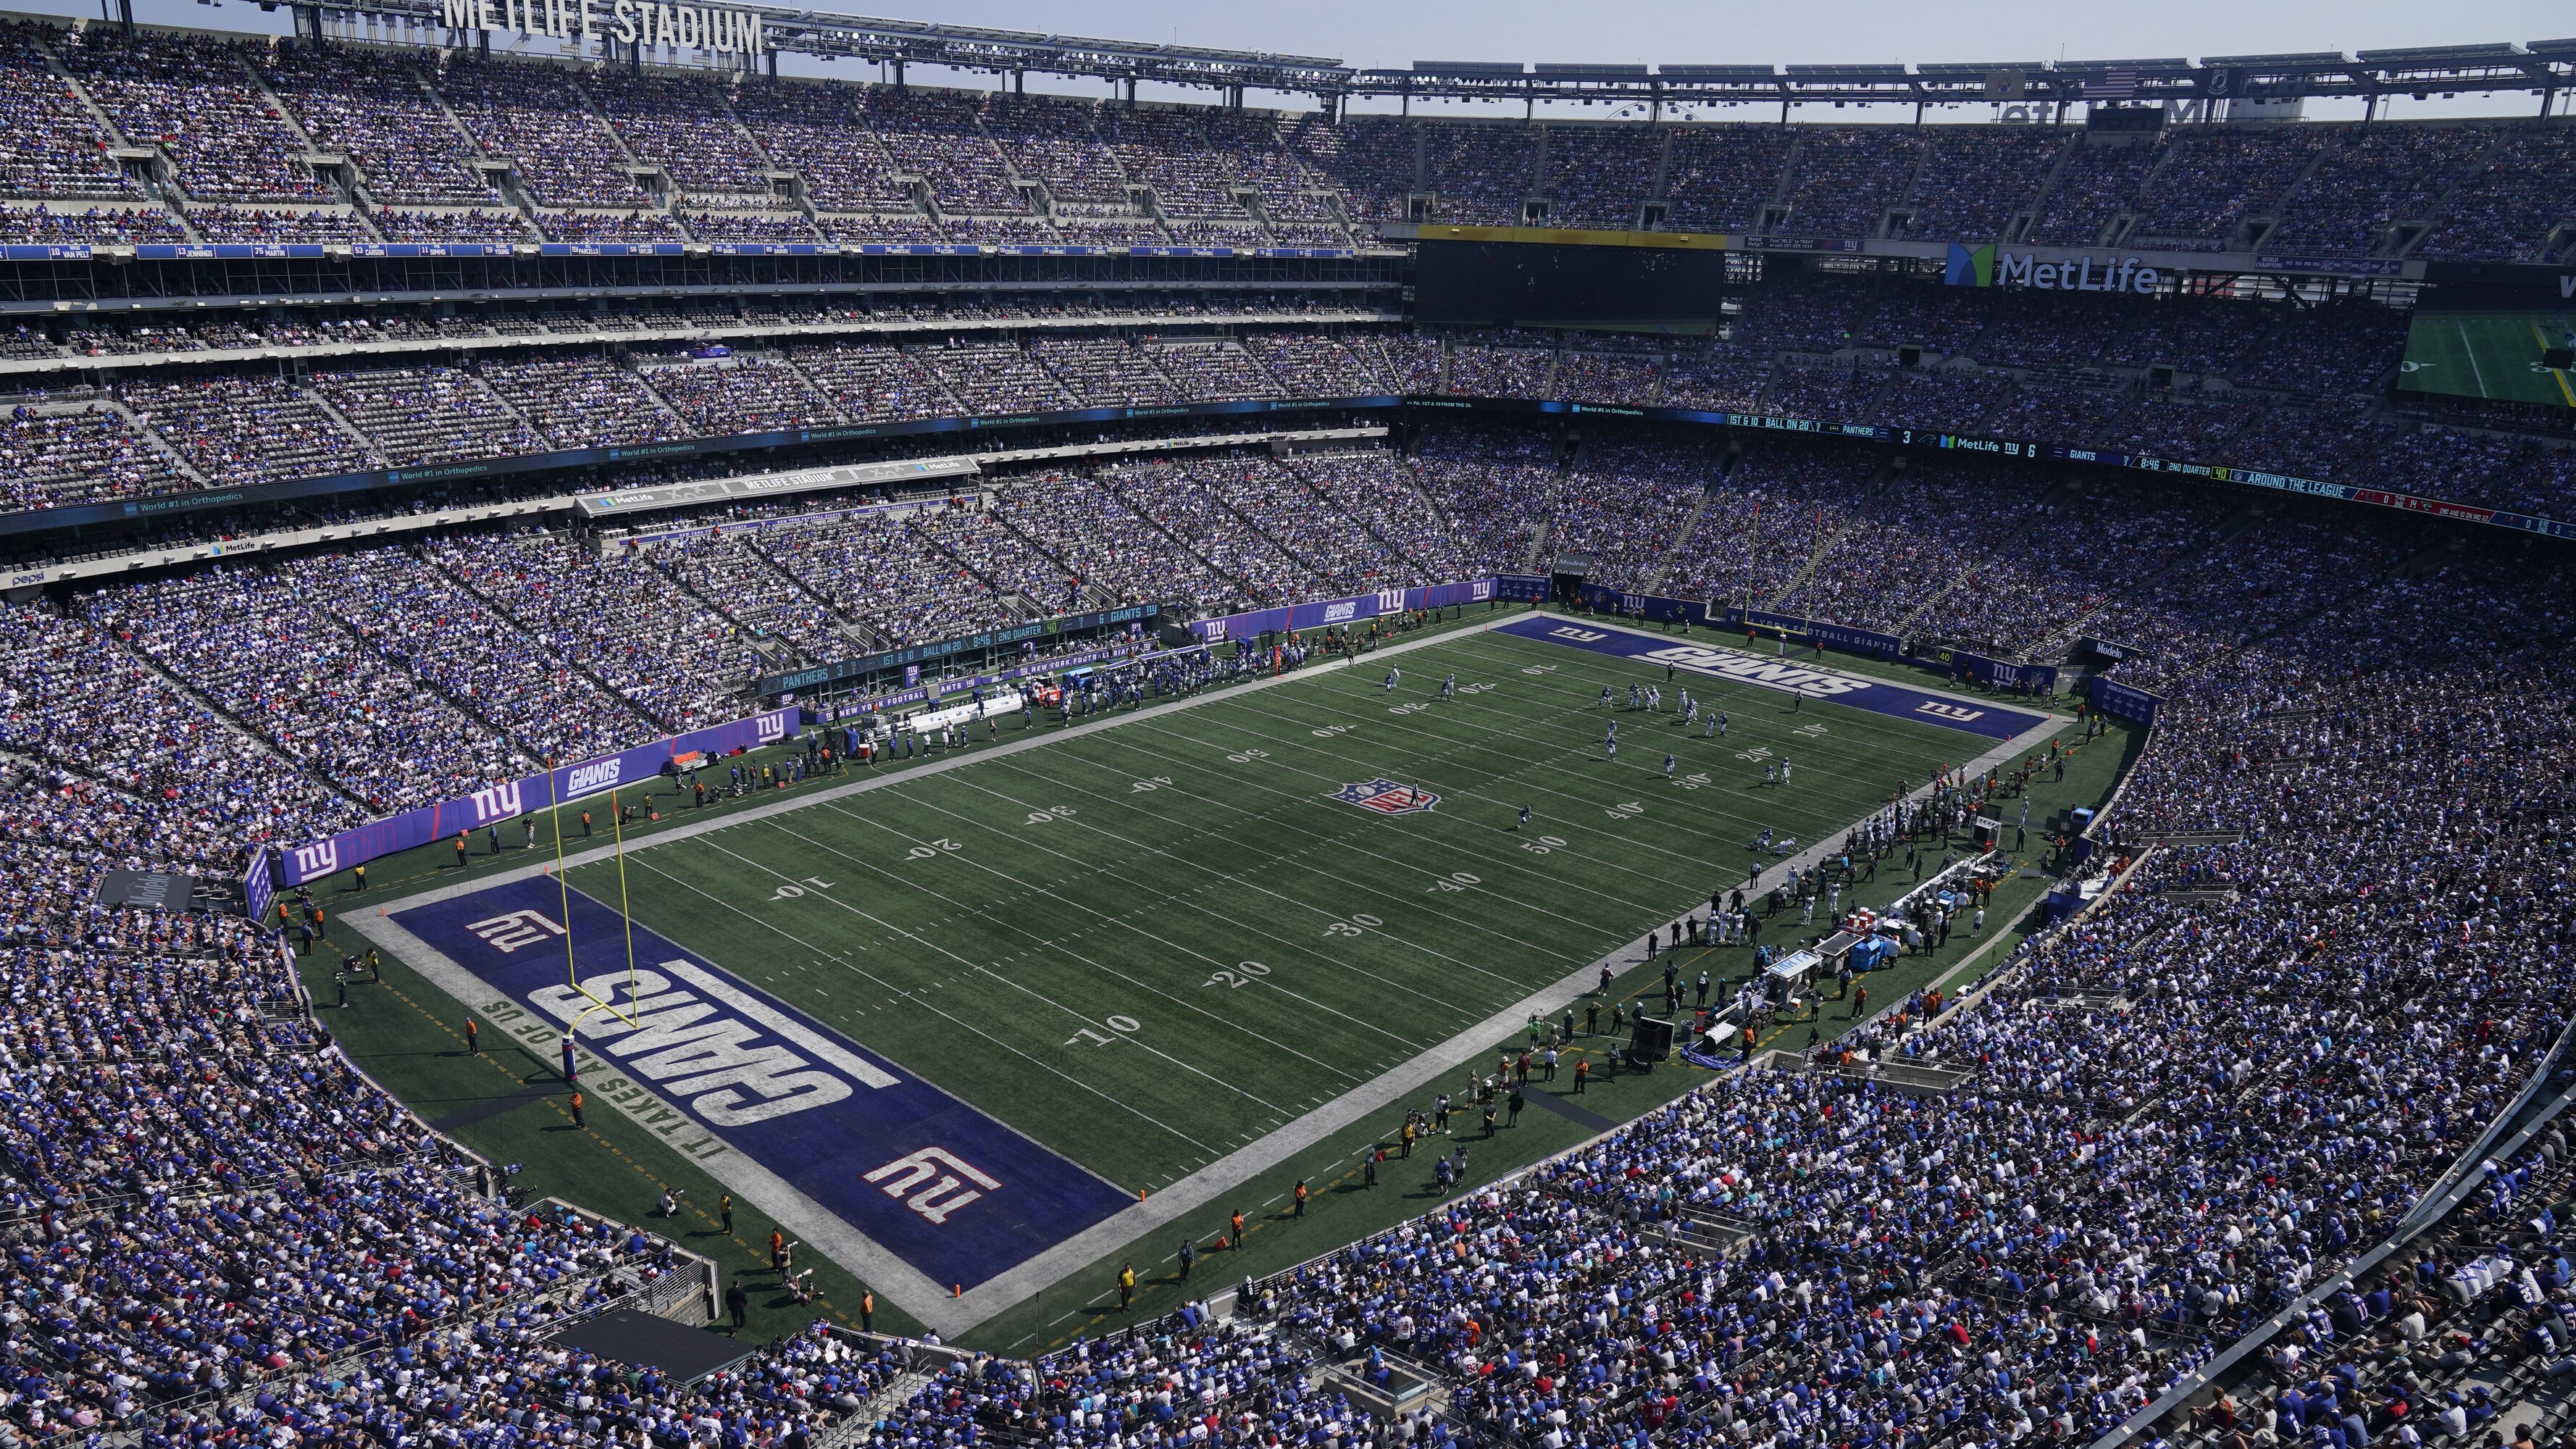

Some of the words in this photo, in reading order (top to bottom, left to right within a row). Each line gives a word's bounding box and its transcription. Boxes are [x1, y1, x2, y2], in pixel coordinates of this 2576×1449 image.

[443, 0, 602, 41] METLIFE
[614, 1, 761, 54] STADIUM
[1998, 253, 2158, 294] MetLife
[1730, 416, 1740, 425] 1ST
[1752, 417, 1758, 426] 10
[1765, 418, 1783, 428] BALL
[1786, 420, 1797, 429] ON
[1843, 425, 1873, 436] PANTHERS
[1903, 430, 1911, 444] 3
[1957, 438, 1999, 452] MetLife
[2004, 442, 2019, 455] ny
[2028, 444, 2036, 458] 6
[2070, 449, 2096, 462] GIANTS
[401, 471, 422, 480] World
[444, 465, 488, 475] Orthopedics
[928, 461, 961, 472] MetLife
[2141, 459, 2159, 469] 8:46
[2169, 462, 2181, 472] 2ND
[2183, 464, 2210, 476] QUARTER
[745, 477, 790, 491] METLIFE
[793, 472, 836, 486] STADIUM
[2216, 469, 2226, 479] 40
[2248, 472, 2285, 489] AROUND
[2288, 479, 2306, 492] THE
[2308, 483, 2345, 498] LEAGUE
[141, 501, 165, 511] World
[192, 493, 243, 505] Orthopedics
[615, 494, 654, 505] MetLife
[2410, 500, 2417, 509] 14
[226, 542, 255, 553] MetLife
[12, 571, 45, 587] pepsi
[1473, 581, 1490, 601] ny
[1378, 589, 1405, 616] ny
[1099, 614, 1104, 624] 6
[1111, 607, 1140, 621] GIANTS
[1146, 604, 1157, 617] ny
[1324, 601, 1356, 622] GIANTS
[998, 630, 1011, 642] 2ND
[1013, 626, 1041, 640] QUARTER
[1047, 622, 1056, 632] 40
[1206, 619, 1226, 641] ny
[974, 636, 990, 647] 8:46
[1854, 636, 1894, 651] GIANTS
[884, 655, 893, 666] 1ST
[898, 653, 903, 662] &
[907, 652, 913, 661] 10
[923, 646, 940, 657] BALL
[942, 644, 950, 653] ON
[953, 642, 961, 651] 20
[1939, 653, 1949, 662] 40
[2096, 642, 2122, 659] Modelo
[837, 665, 842, 677] 3
[907, 665, 917, 677] ny
[1032, 664, 1047, 672] NEW
[1050, 659, 1070, 669] YORK
[1074, 653, 1109, 664] FOOTBALL
[1522, 664, 1556, 675] 10
[783, 669, 827, 688] PANTHERS
[1645, 646, 1871, 701] GIANTS
[1994, 662, 2016, 687] ny
[1459, 682, 1495, 695] 20
[2107, 684, 2121, 693] WORLD
[2123, 688, 2149, 701] CHAMPIONS
[840, 707, 858, 717] NEW
[887, 692, 924, 706] FOOTBAL
[1389, 701, 1429, 715] 30
[756, 712, 784, 742] ny
[1313, 724, 1351, 739] 40
[1793, 727, 1828, 739] 10
[1226, 748, 1270, 763] 50
[1736, 748, 1773, 764] 20
[567, 758, 620, 796] GIANTS
[1132, 776, 1173, 791] 40
[1672, 775, 1712, 790] 30
[471, 781, 522, 824] ny
[1027, 806, 1076, 824] 30
[1605, 803, 1644, 824] 40
[910, 838, 962, 859] 20
[1526, 835, 1568, 855] 50
[296, 838, 338, 882] ny
[775, 875, 836, 898] 10
[1434, 871, 1481, 893] 40
[464, 910, 566, 953] ny
[1330, 913, 1384, 938] 30
[1213, 961, 1271, 988] 20
[481, 1000, 525, 1024] US
[514, 1026, 558, 1045] OF
[1076, 1014, 1141, 1048] 10
[527, 969, 854, 1127] GIANTS
[598, 1077, 688, 1136] TAKES
[682, 1137, 727, 1161] IT
[861, 1145, 1003, 1224] ny
